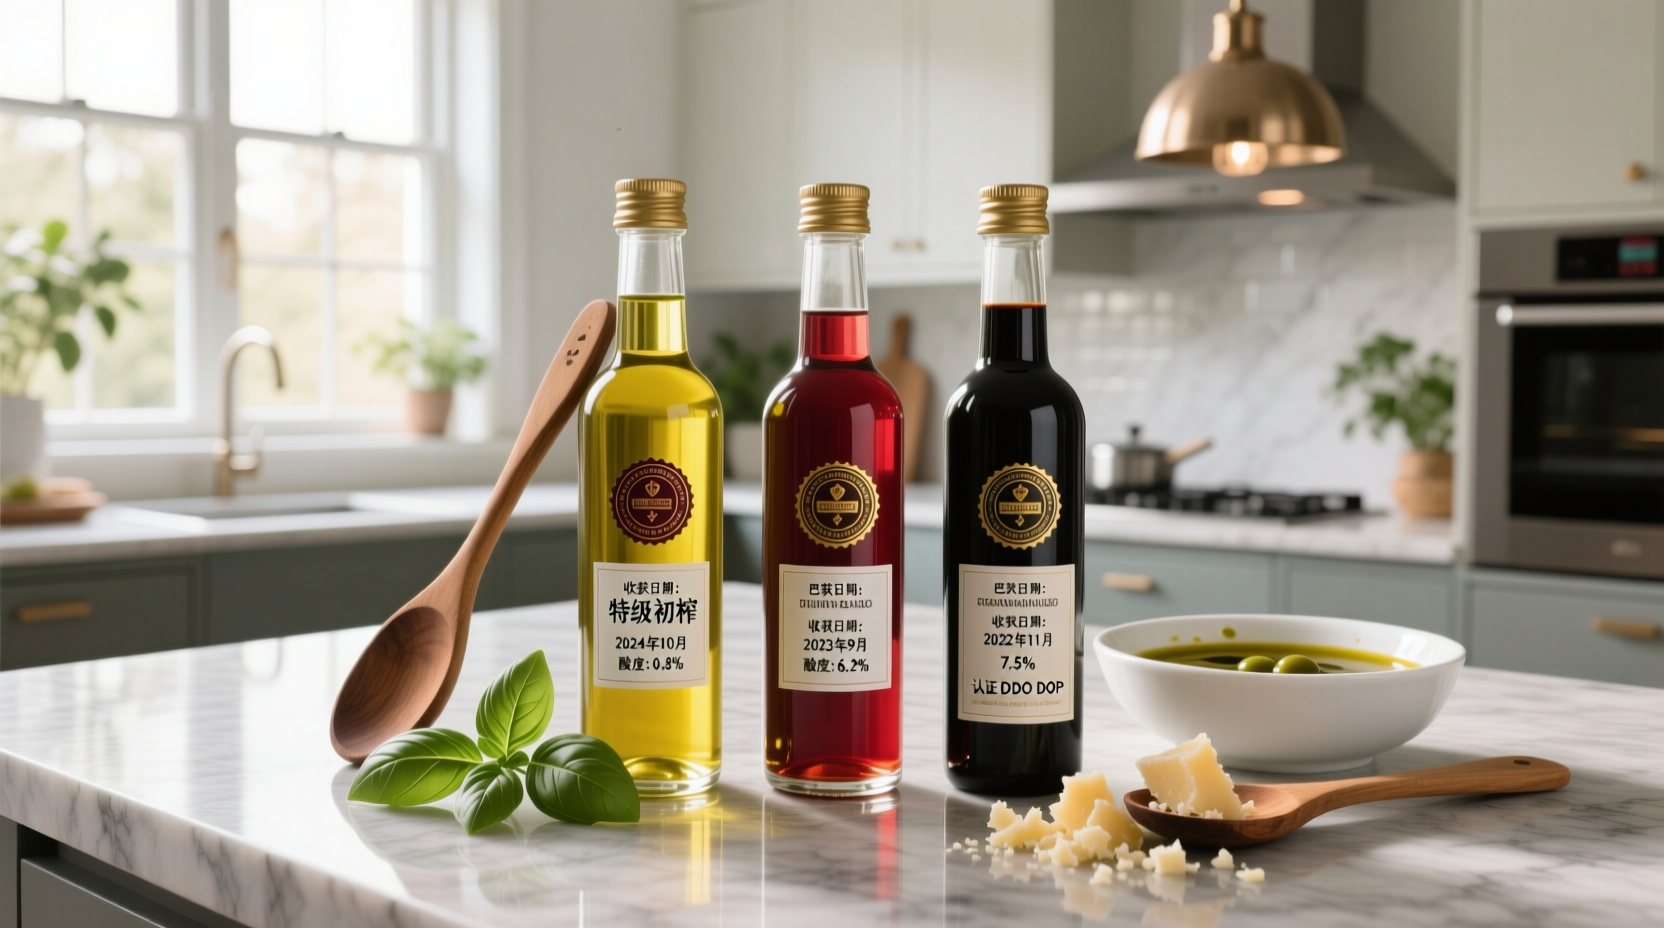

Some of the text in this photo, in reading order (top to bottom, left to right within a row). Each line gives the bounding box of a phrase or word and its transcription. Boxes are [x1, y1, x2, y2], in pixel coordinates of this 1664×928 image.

[609, 597, 698, 624] 特级初榨
[615, 635, 686, 651] 2024年10月
[803, 637, 867, 653] 2023年9月
[984, 632, 1052, 648] 2022年11月
[1000, 681, 1033, 695] DDO
[1036, 680, 1064, 694] DOP
